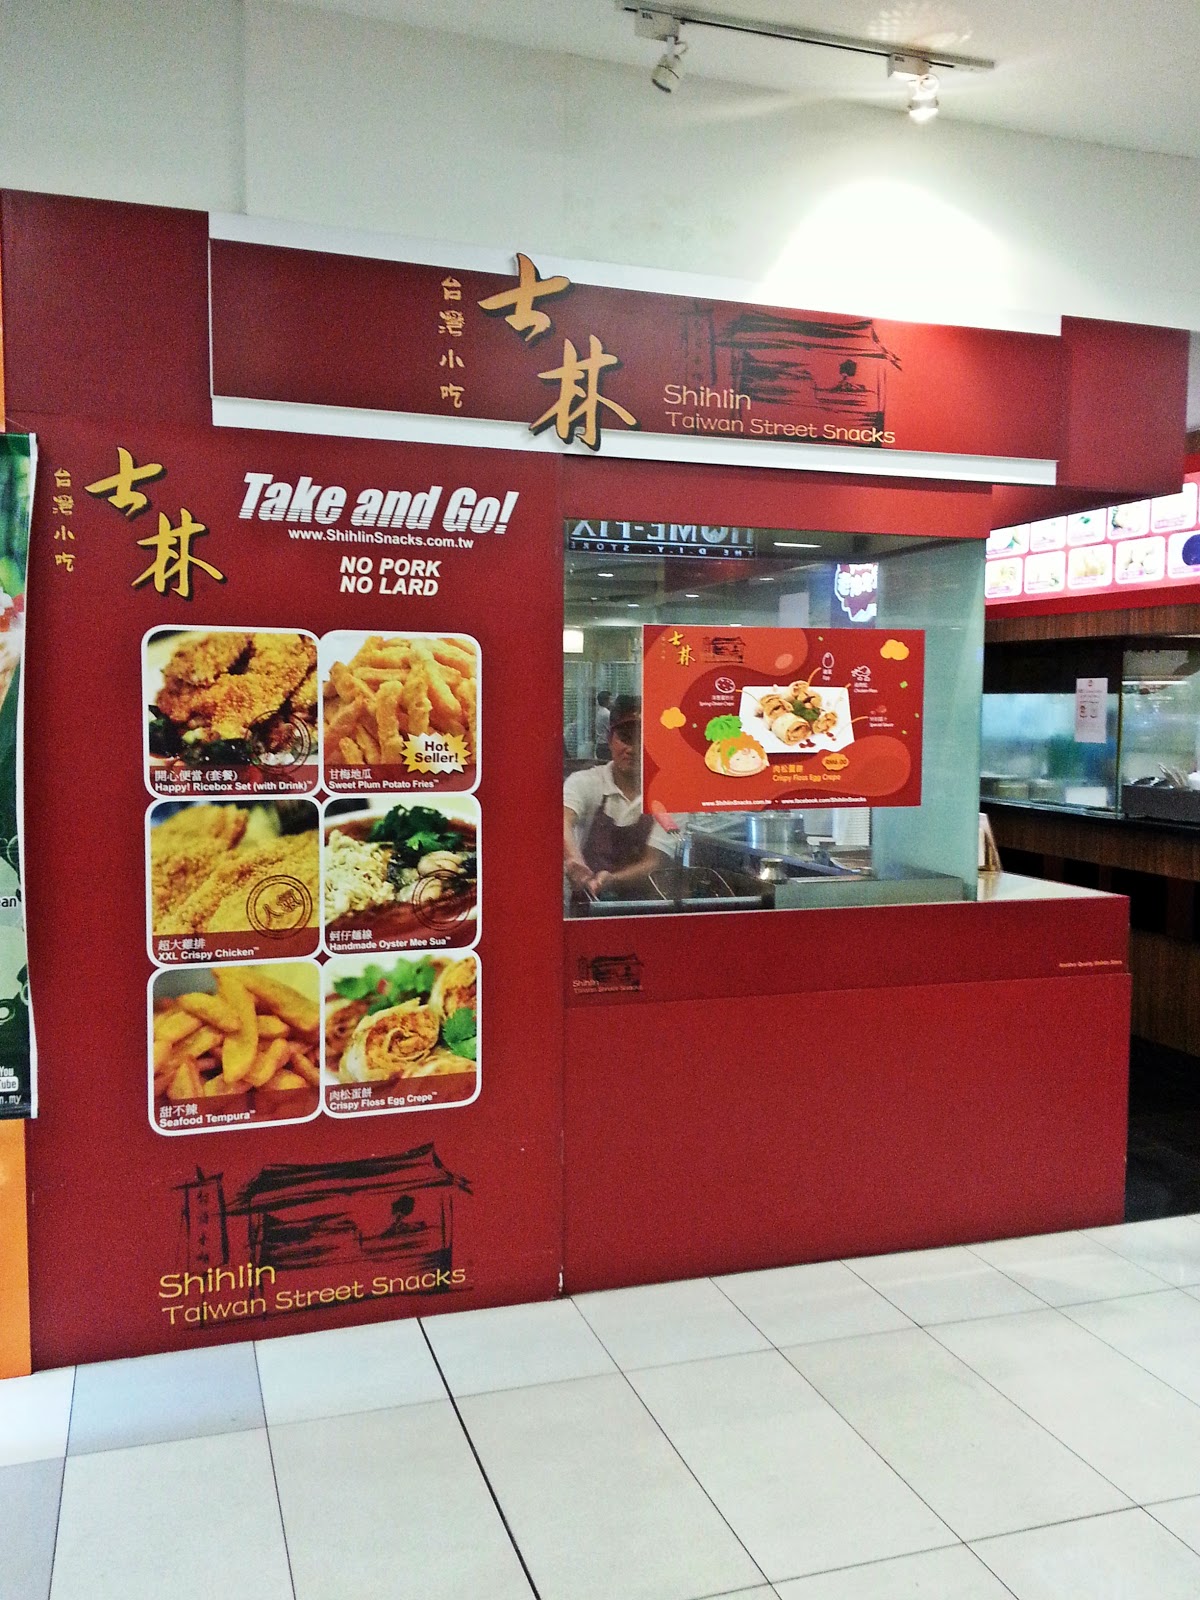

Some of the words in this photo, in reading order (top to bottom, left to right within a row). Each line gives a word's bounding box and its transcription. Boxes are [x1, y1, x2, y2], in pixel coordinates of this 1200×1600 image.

[477, 253, 637, 450] 士林
[663, 384, 752, 411] Shihlin
[666, 411, 744, 433] Taiwan
[750, 418, 816, 439] Street
[823, 423, 896, 445] Snacks
[239, 472, 346, 526] Take
[349, 485, 444, 534] and
[444, 487, 519, 535] Go!
[85, 447, 226, 599] 士林
[289, 528, 474, 549] www.ShihlinSnacks.com.tw
[340, 556, 374, 576] NO
[379, 556, 441, 578] PORK
[340, 576, 374, 595] NO
[379, 577, 440, 597] LARD
[424, 741, 449, 752] Hot
[414, 752, 459, 763] Seller!
[154, 782, 190, 793] Happy!
[193, 782, 233, 792] Ricebox
[235, 782, 252, 792] Set
[253, 782, 277, 792] (with
[329, 780, 357, 790] Sweet
[358, 780, 381, 789] Plum
[382, 780, 411, 789] Potato
[157, 951, 179, 961] XXL
[180, 950, 214, 961] Crispy
[329, 941, 377, 952] Handmade
[378, 939, 408, 950] Oyster
[409, 938, 428, 947] Mee
[0, 1079, 17, 1089] ube
[329, 1100, 359, 1112] Crispy
[360, 1097, 386, 1108] Floss
[387, 1095, 405, 1106] Egg
[159, 1116, 203, 1128] Seafood
[158, 1262, 277, 1299] Shihlin
[162, 1297, 267, 1325] Taiwan
[276, 1280, 364, 1310] Street
[371, 1267, 467, 1294] Snacks
